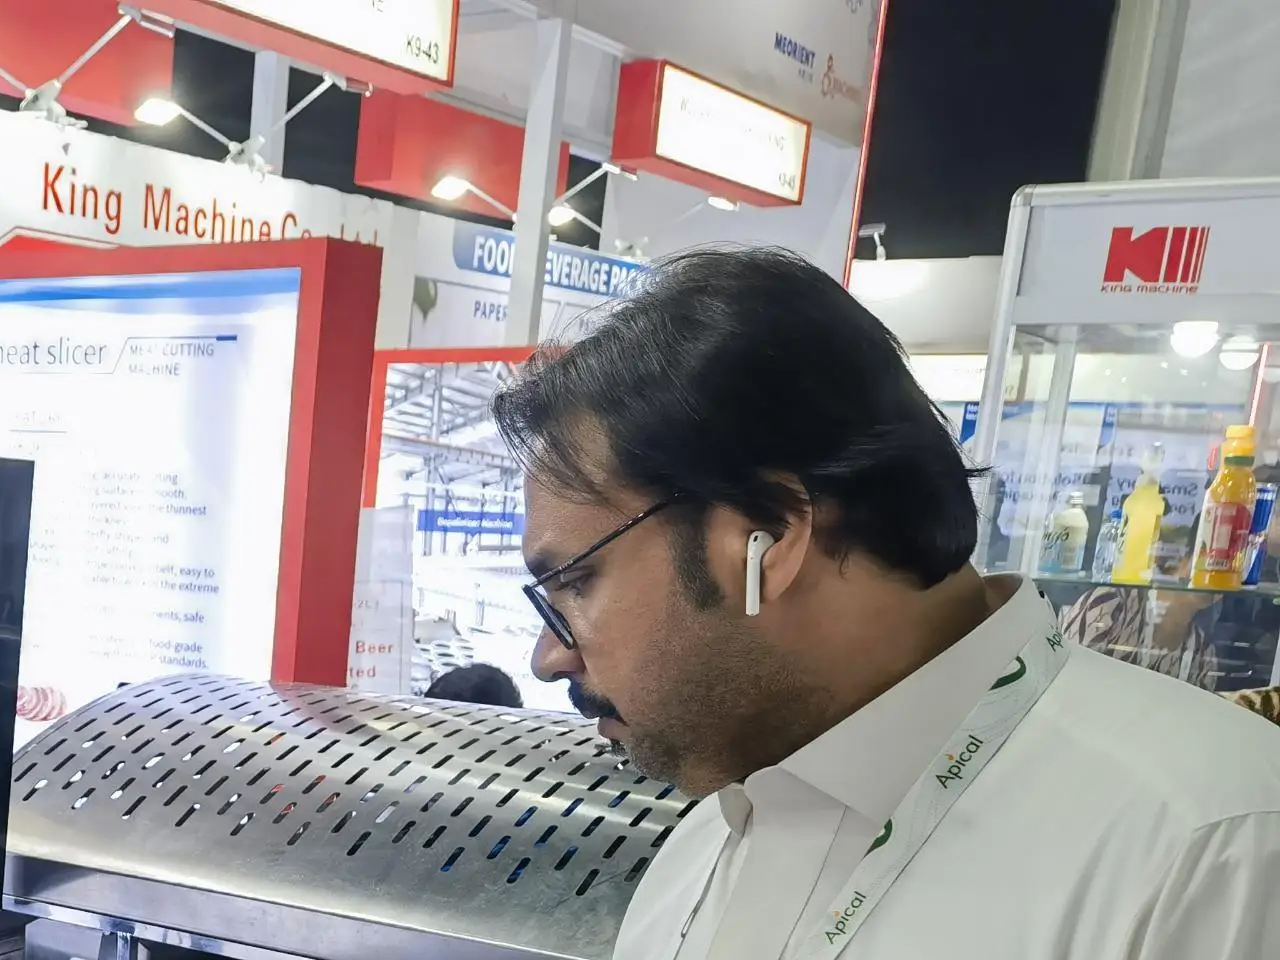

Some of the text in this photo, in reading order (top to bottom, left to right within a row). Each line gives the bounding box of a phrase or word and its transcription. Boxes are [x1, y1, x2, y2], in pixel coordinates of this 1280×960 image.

[42, 162, 122, 235] King
[144, 183, 271, 243] Machine
[545, 251, 610, 293] EVERAGE
[47, 338, 108, 366] slicer
[162, 342, 216, 358] CUTTING
[166, 504, 207, 516] thinnest
[179, 567, 202, 580] easy
[204, 568, 215, 579] to
[160, 580, 177, 590] the
[178, 583, 220, 594] extreme
[183, 611, 205, 623] safe
[355, 639, 394, 654] Beer
[933, 734, 983, 791] Apical
[823, 890, 867, 945] Apical
